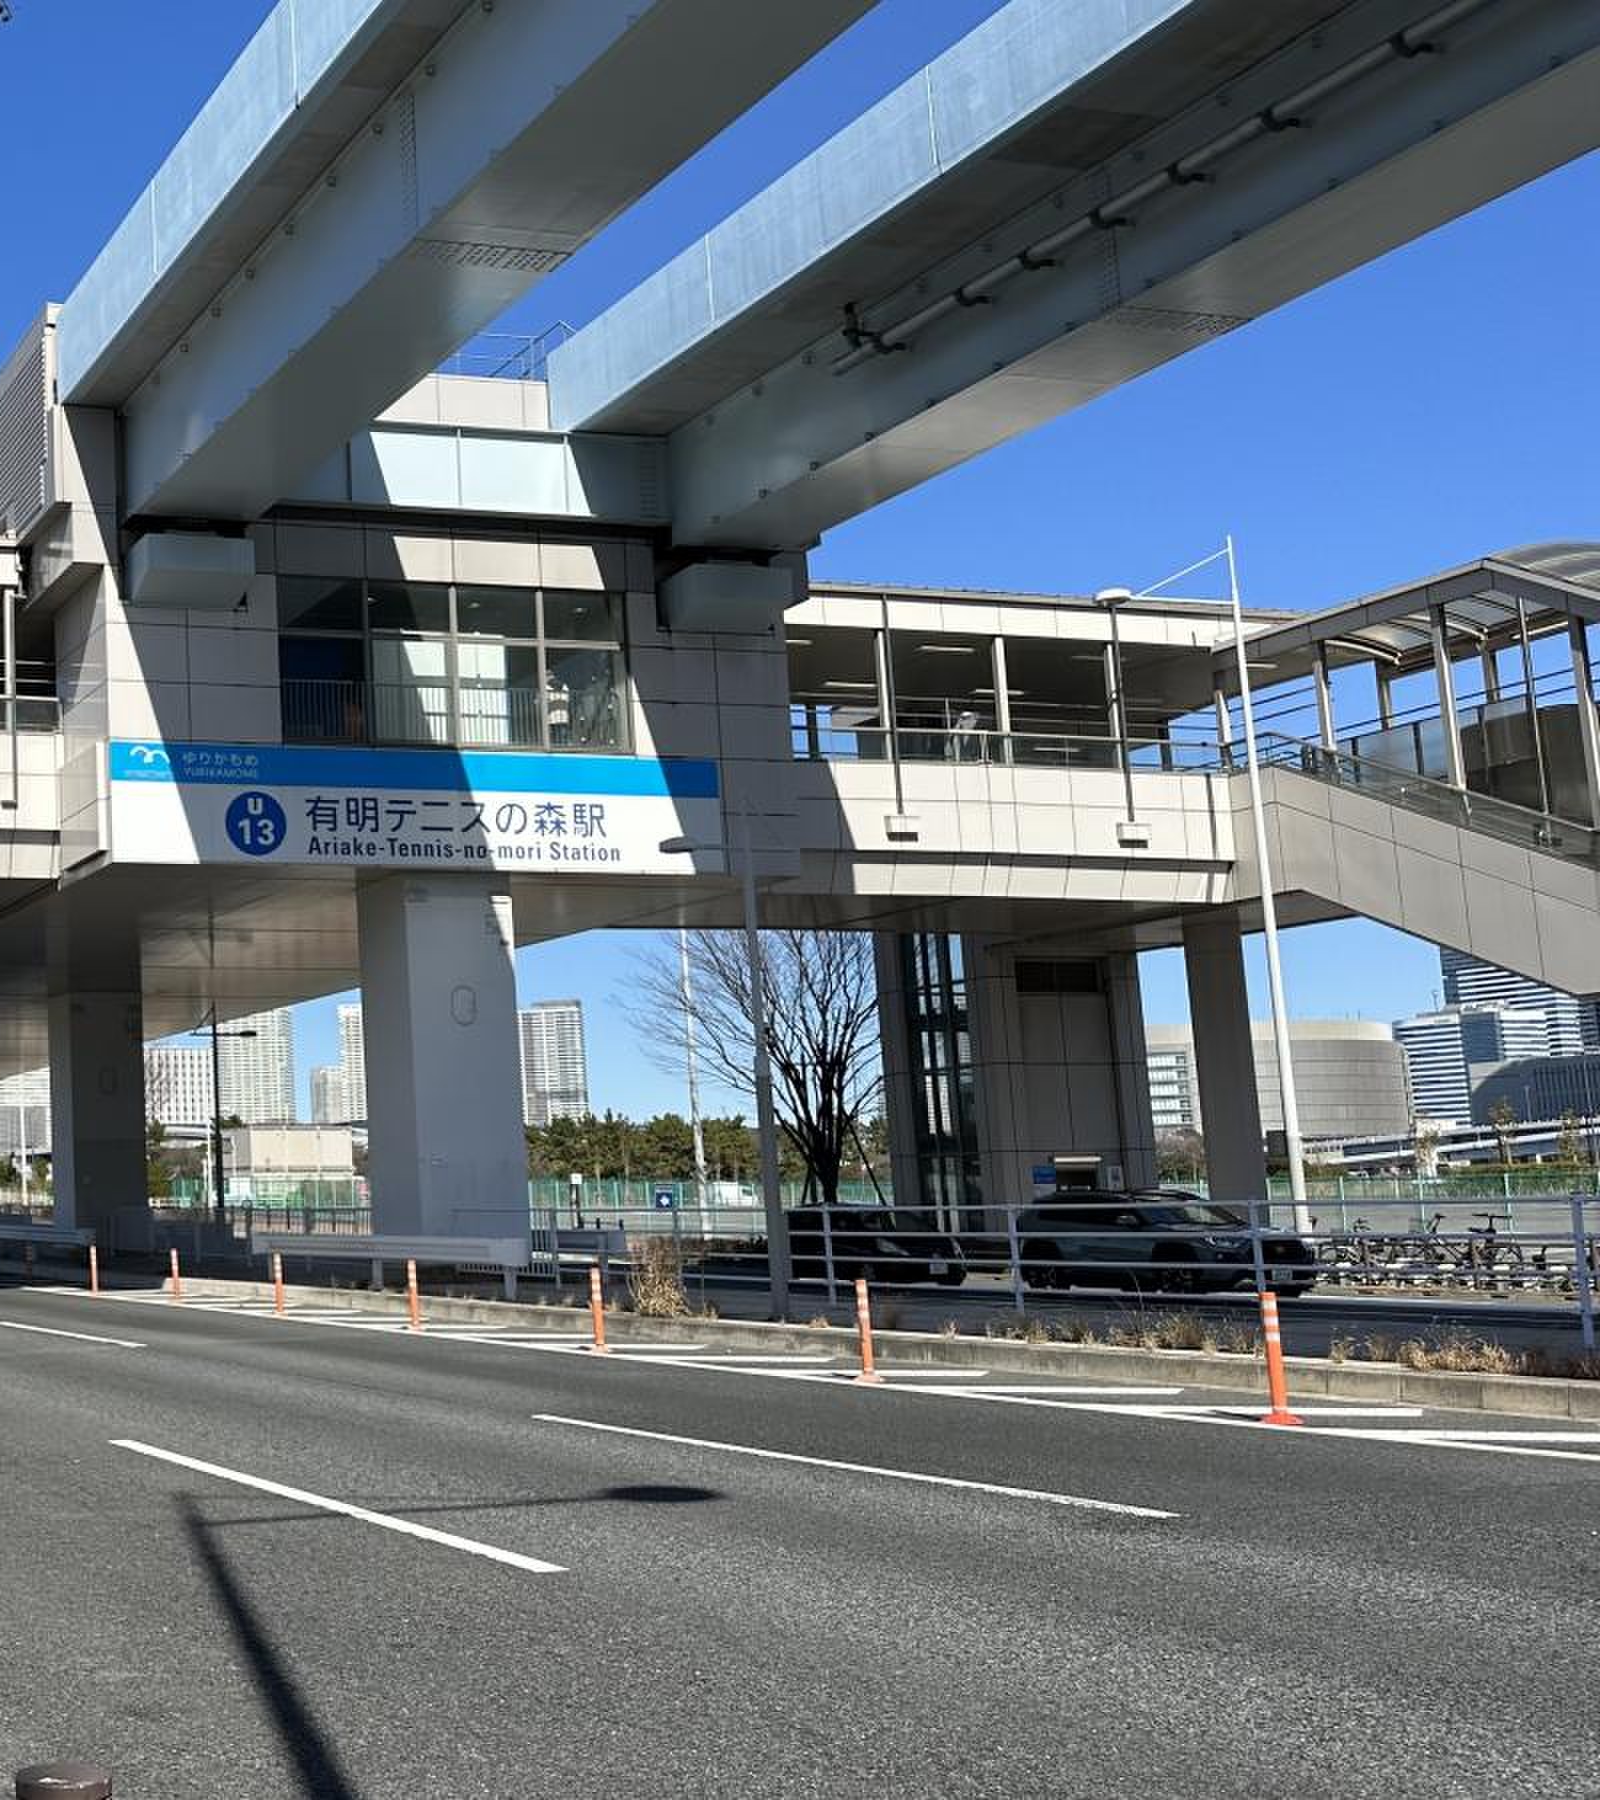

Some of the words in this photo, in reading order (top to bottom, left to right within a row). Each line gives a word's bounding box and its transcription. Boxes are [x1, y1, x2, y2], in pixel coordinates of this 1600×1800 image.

[183, 752, 258, 767] ゆりかもめ
[247, 798, 263, 815] U
[305, 795, 608, 838] 有明テニスの森駅
[238, 818, 276, 846] 13
[308, 836, 542, 860] Ariake-Tennis-no-mori
[550, 841, 621, 862] Station
